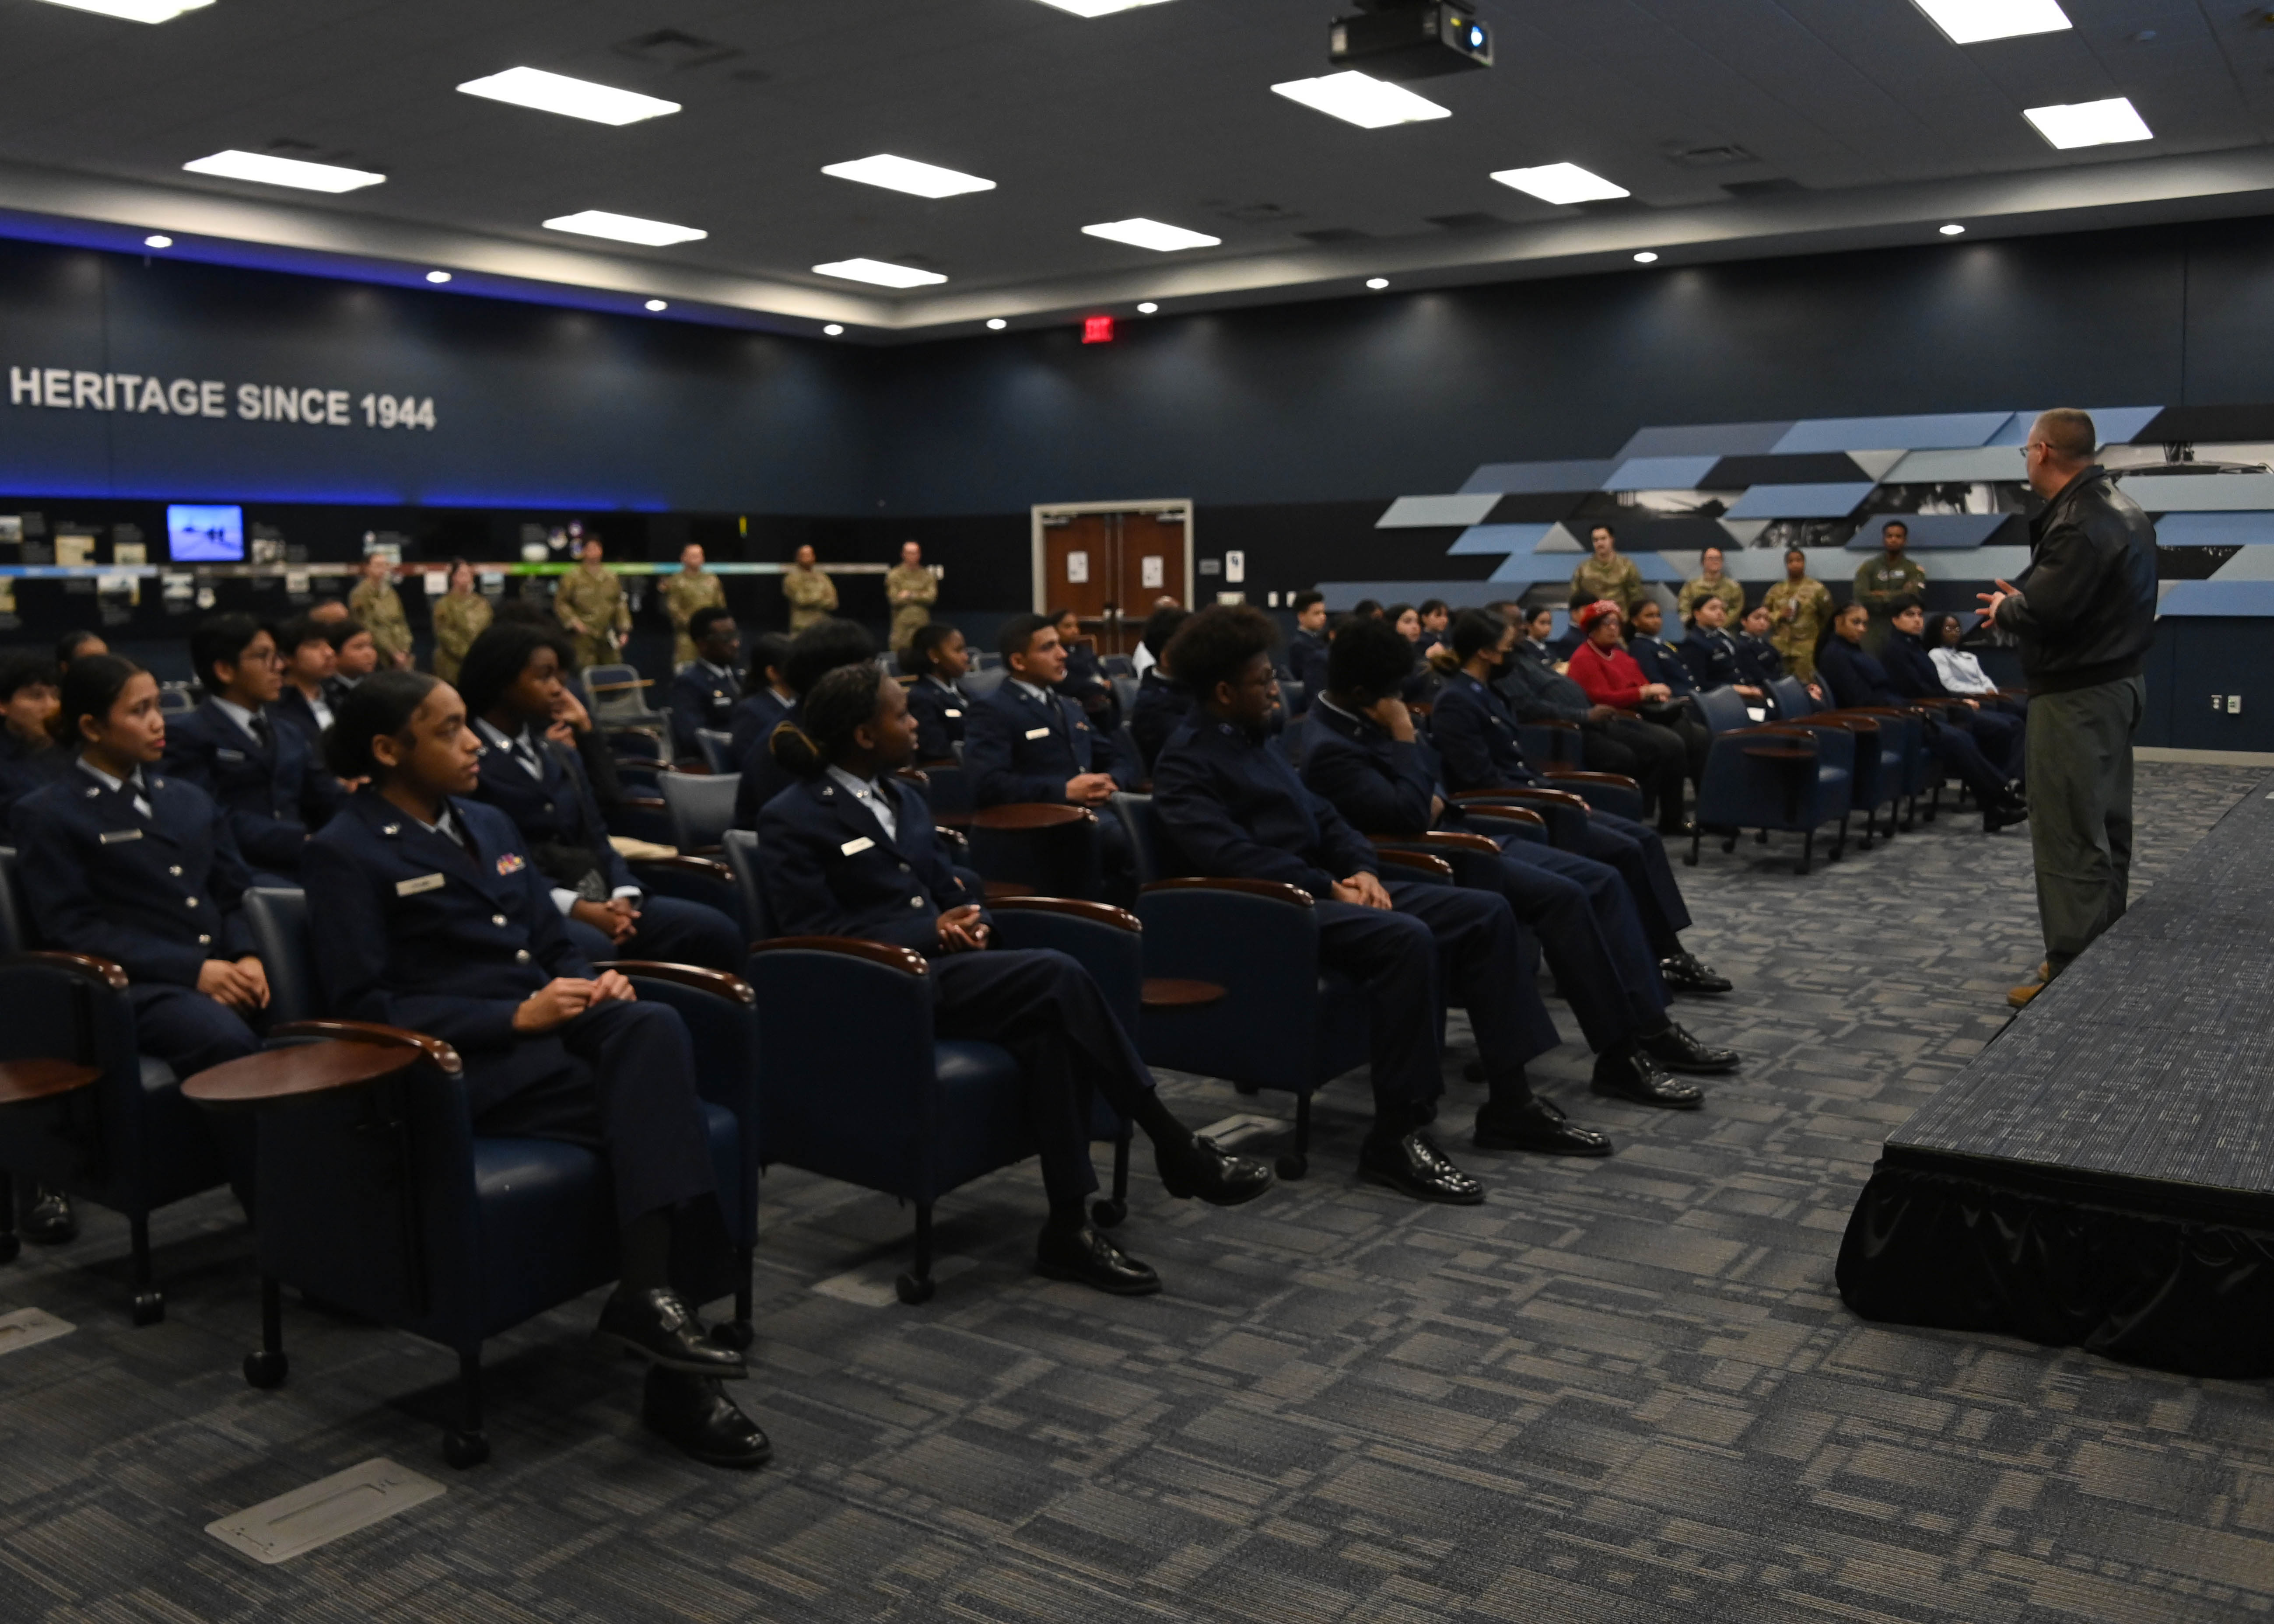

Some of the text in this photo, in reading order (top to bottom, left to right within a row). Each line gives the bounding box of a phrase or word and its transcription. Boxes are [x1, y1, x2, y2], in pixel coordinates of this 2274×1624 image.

[10, 367, 436, 430] HERITAGE SINCE 1944
